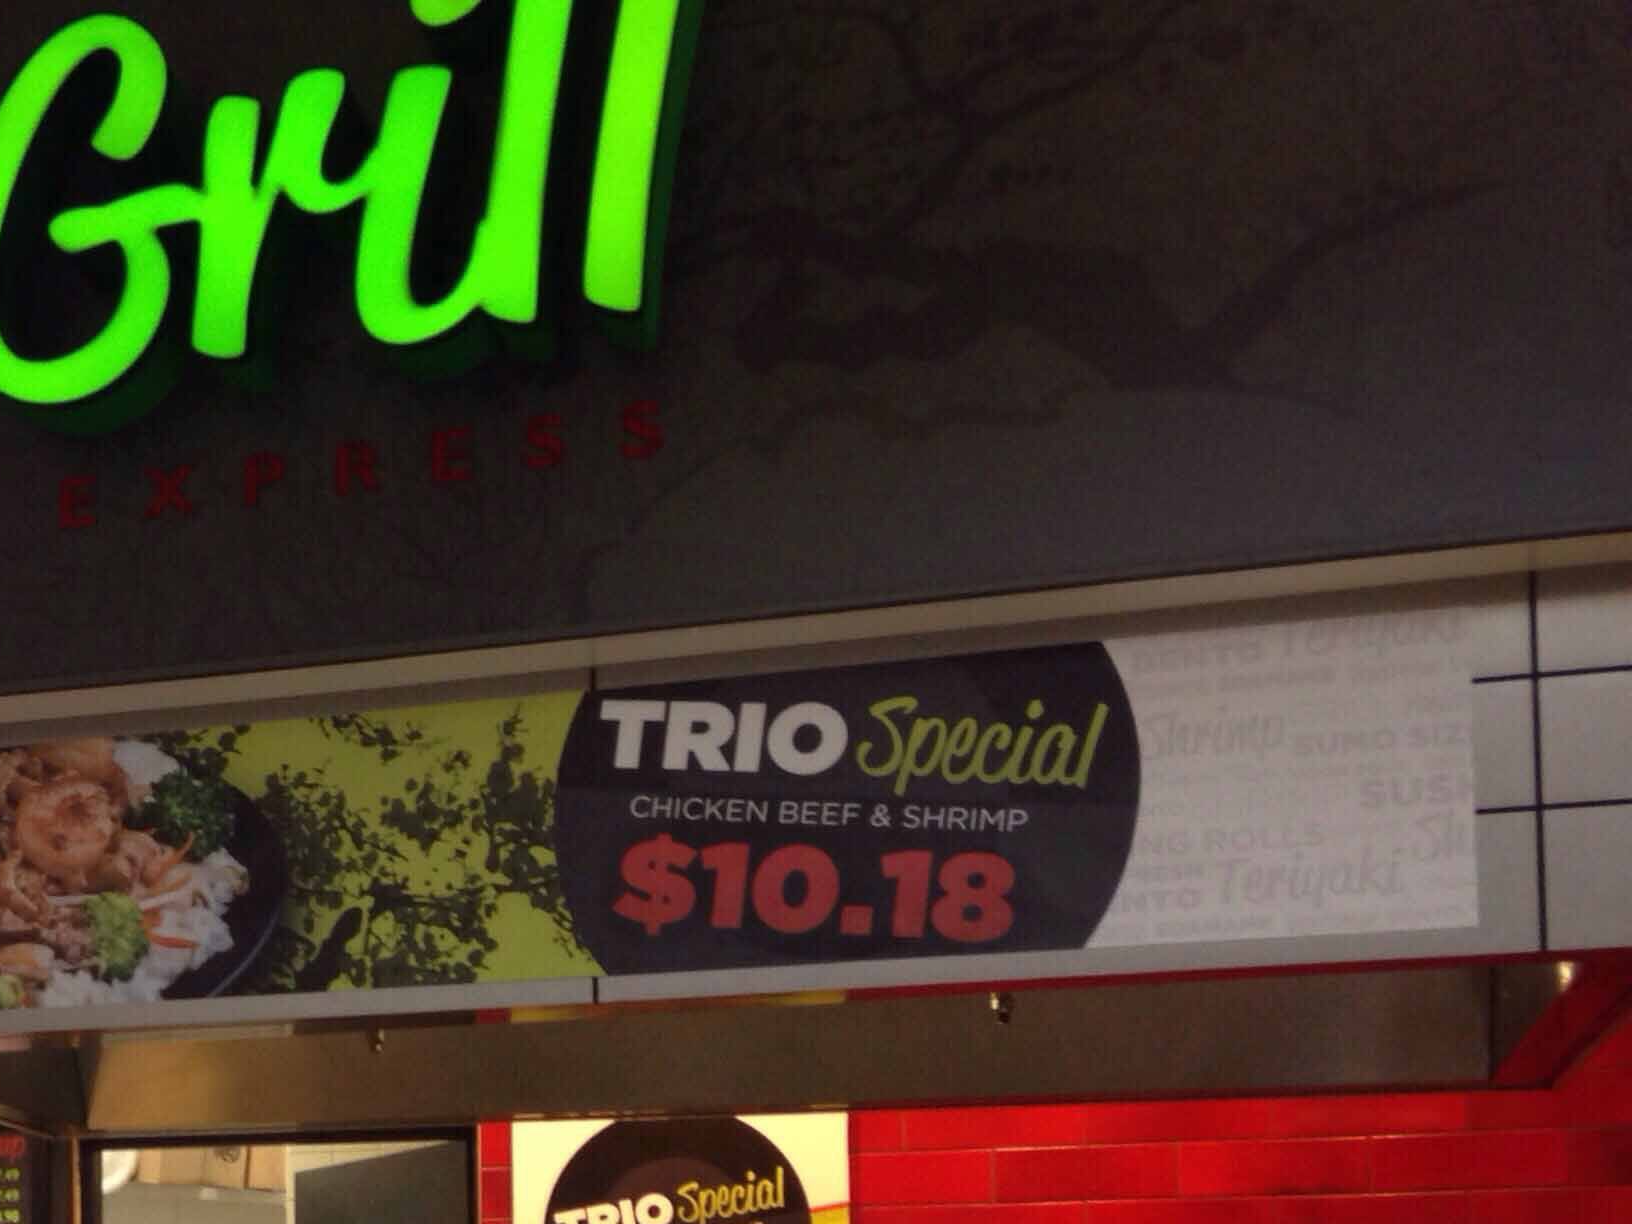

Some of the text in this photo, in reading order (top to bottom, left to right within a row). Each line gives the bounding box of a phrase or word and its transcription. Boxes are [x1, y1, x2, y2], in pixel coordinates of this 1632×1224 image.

[57, 401, 665, 530] EXPRESS
[600, 696, 1108, 797] TRIO Special
[630, 796, 1028, 832] CHICKEN BEEF & SHRIMP
[612, 833, 1015, 943] $10.18
